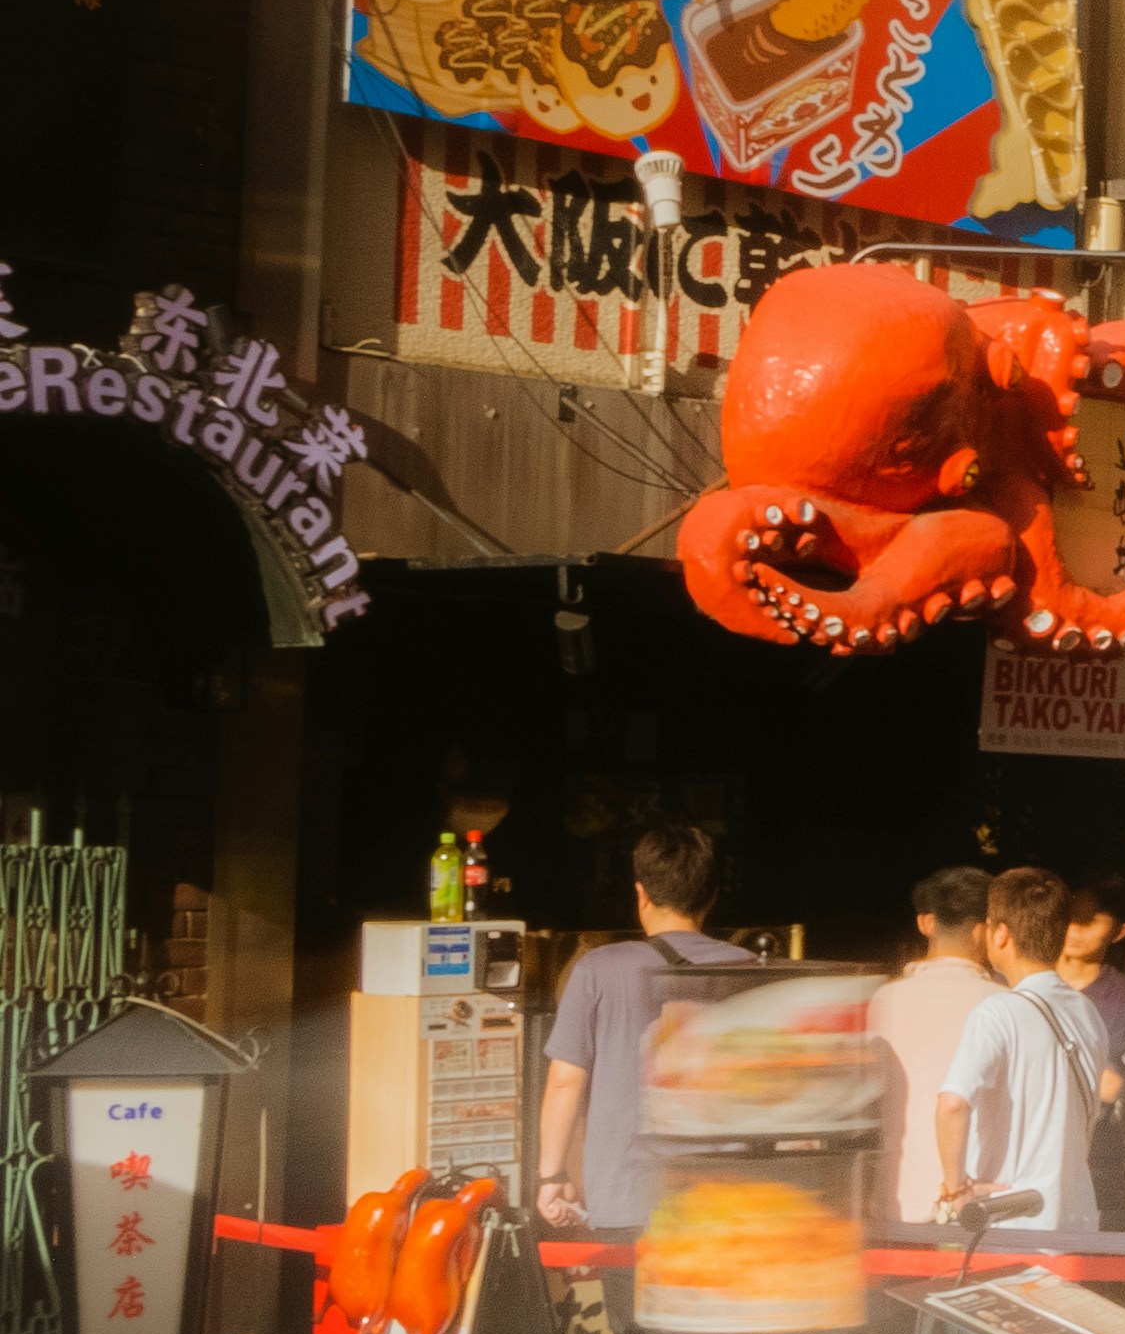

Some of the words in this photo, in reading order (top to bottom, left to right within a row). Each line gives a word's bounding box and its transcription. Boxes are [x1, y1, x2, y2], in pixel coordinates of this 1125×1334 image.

[996, 658, 1119, 700] BIKKURI
[108, 1102, 163, 1121] Cafe
[106, 1150, 157, 1320] 喫茶店
